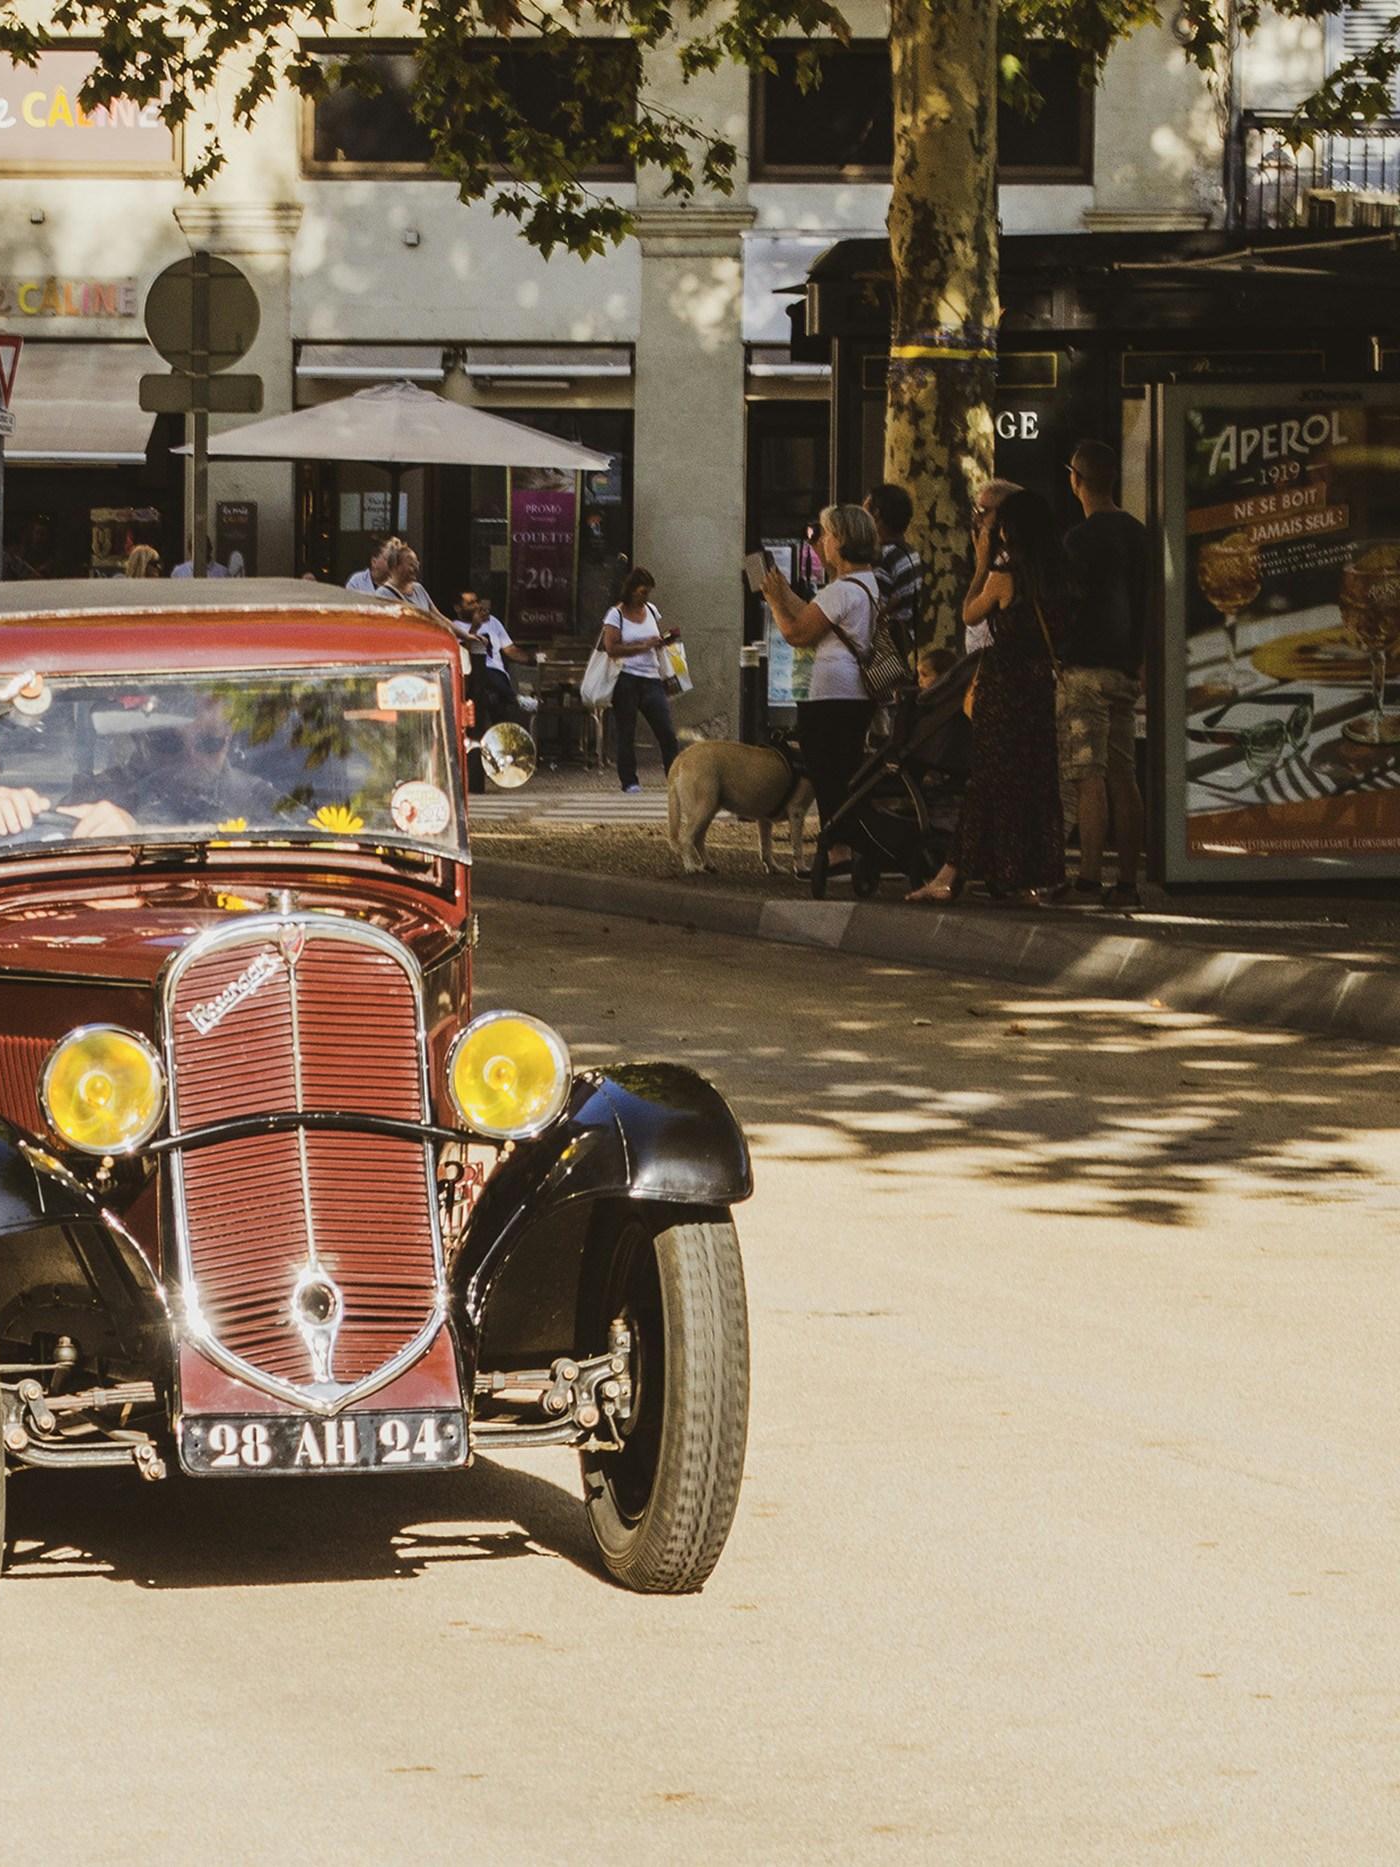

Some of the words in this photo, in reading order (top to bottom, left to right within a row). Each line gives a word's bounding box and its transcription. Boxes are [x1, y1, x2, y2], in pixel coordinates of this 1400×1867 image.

[1208, 411, 1349, 477] APEROL
[1259, 461, 1301, 486] 1919
[525, 504, 562, 515] PROMO
[1233, 500, 1255, 520] NE
[1259, 496, 1277, 514] SE
[1282, 488, 1318, 508] BOIT
[512, 531, 574, 544] COUETTE
[1250, 518, 1304, 543] JAMAIS
[208, 1423, 272, 1467] 28
[294, 1420, 358, 1466] AH
[379, 1418, 442, 1463] 24
